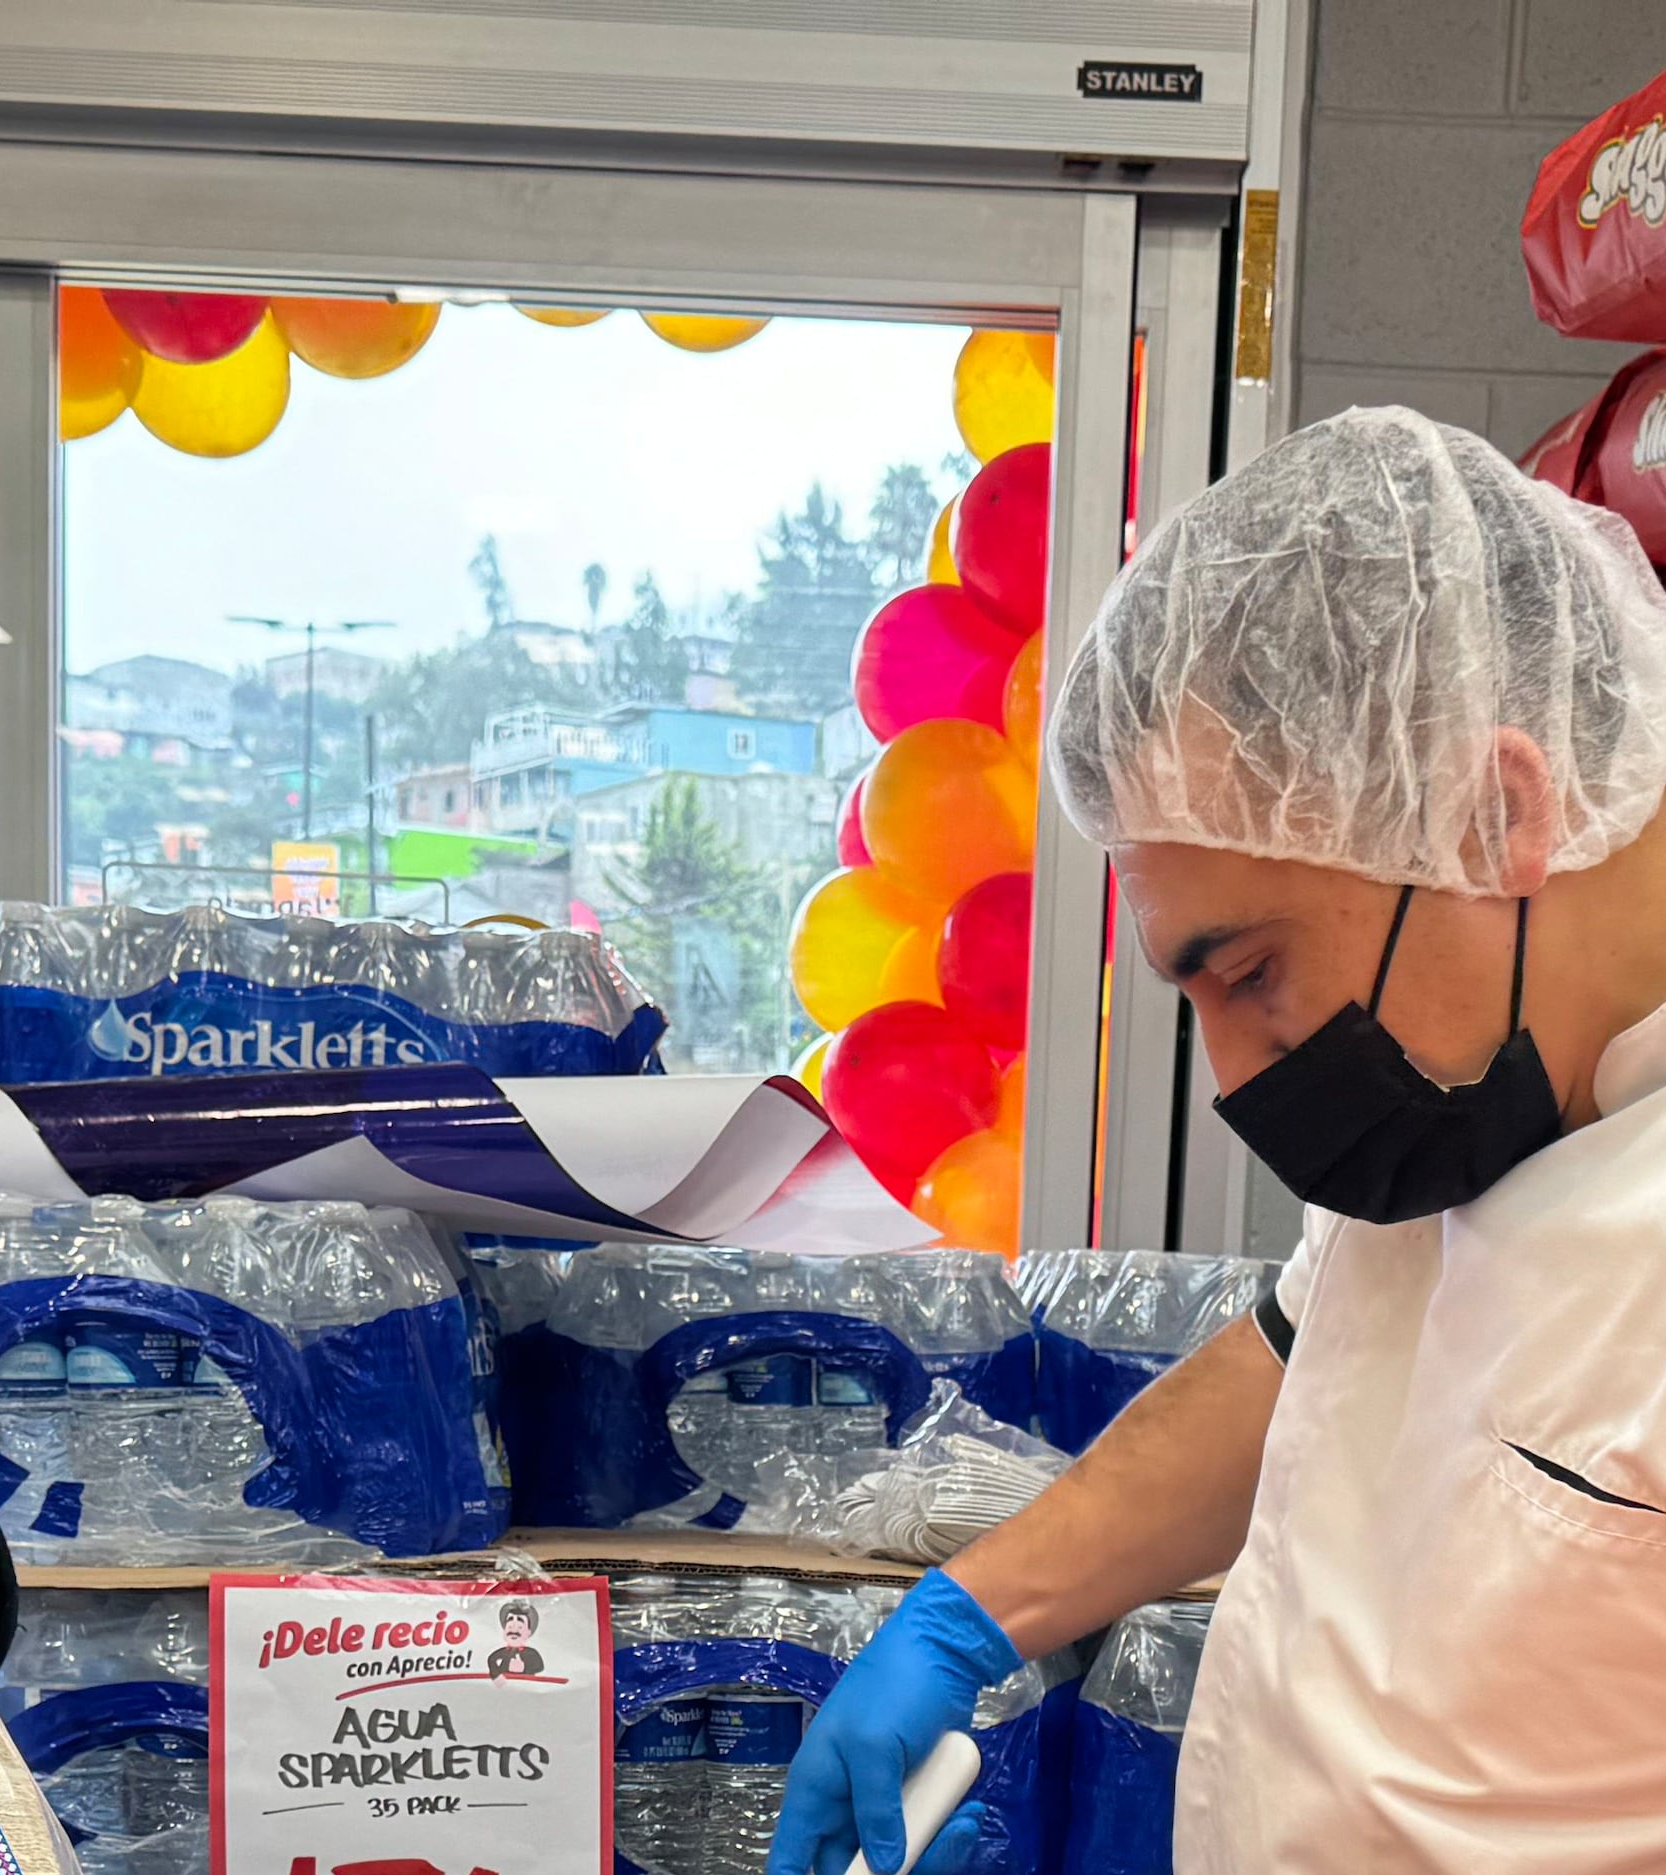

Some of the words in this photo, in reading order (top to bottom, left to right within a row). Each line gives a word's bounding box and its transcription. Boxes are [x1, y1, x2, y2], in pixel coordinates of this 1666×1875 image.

[1085, 70, 1195, 94] STANLEY
[123, 1006, 426, 1069] Sparkletts
[259, 1616, 365, 1670] ¡Dele
[372, 1611, 470, 1651] recio
[346, 1660, 383, 1679] con
[386, 1650, 473, 1678] Aprecio!
[332, 1702, 456, 1749] AGUA
[278, 1743, 551, 1790] SPARKLETTS
[367, 1797, 400, 1819] 35
[407, 1795, 463, 1817] PACK
